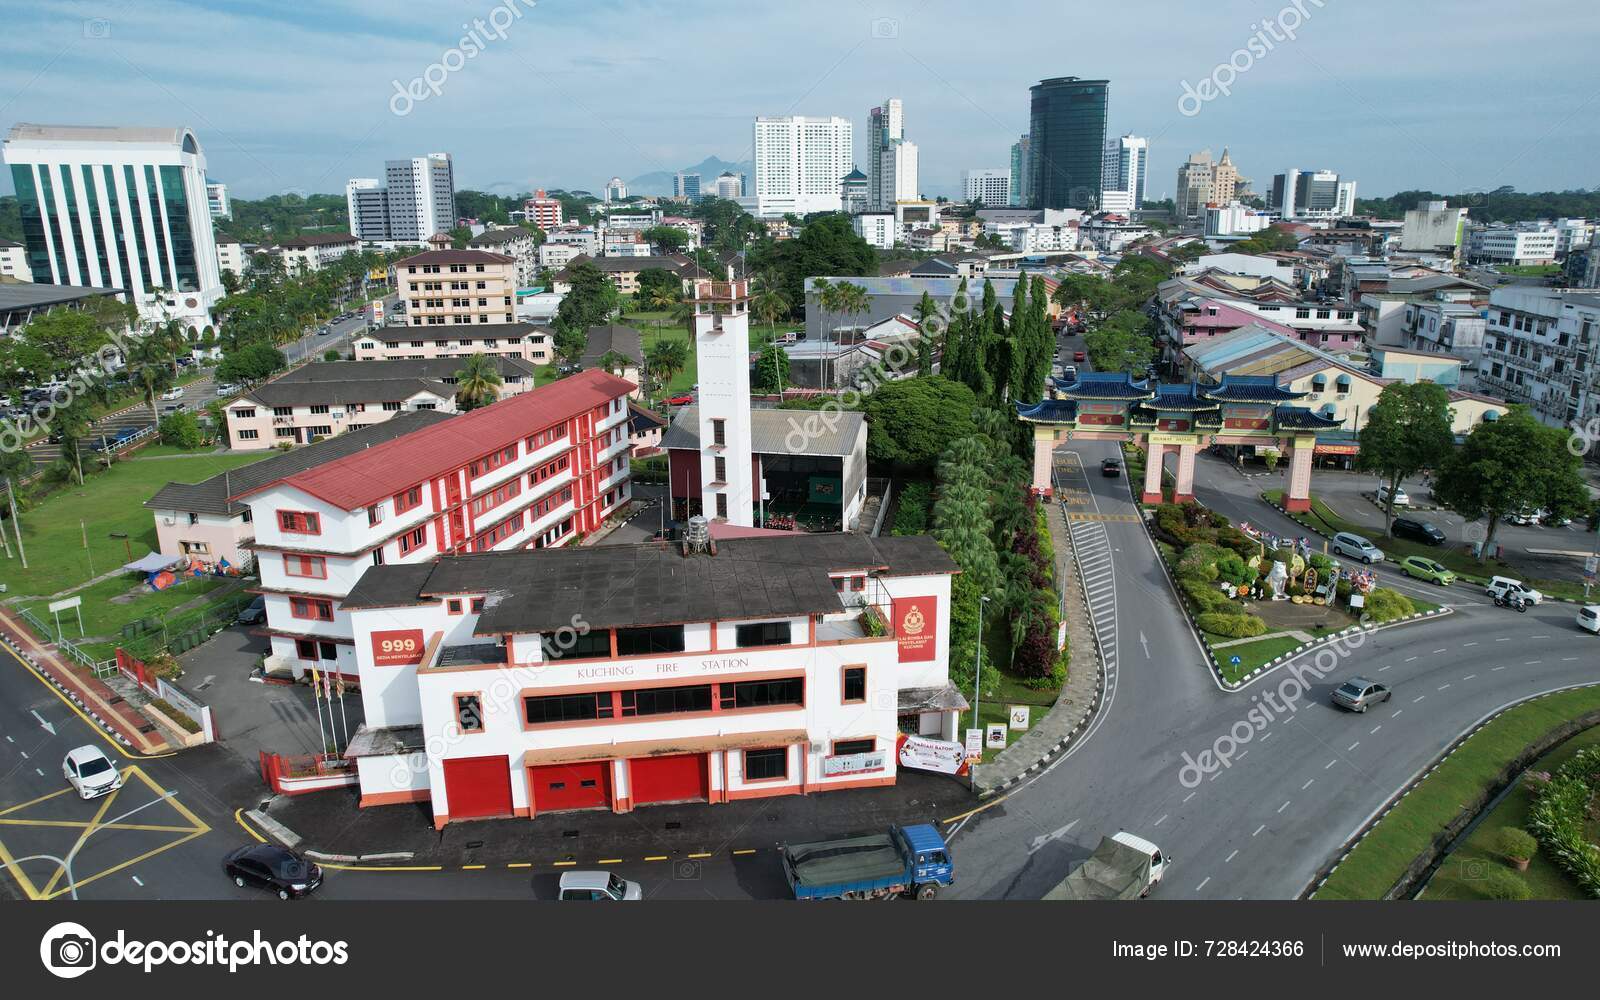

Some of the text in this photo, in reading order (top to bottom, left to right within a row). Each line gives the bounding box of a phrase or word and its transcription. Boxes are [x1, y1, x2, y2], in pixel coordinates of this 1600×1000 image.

[381, 638, 416, 653] 999
[577, 658, 750, 679] KUCHING FIRE STATION
